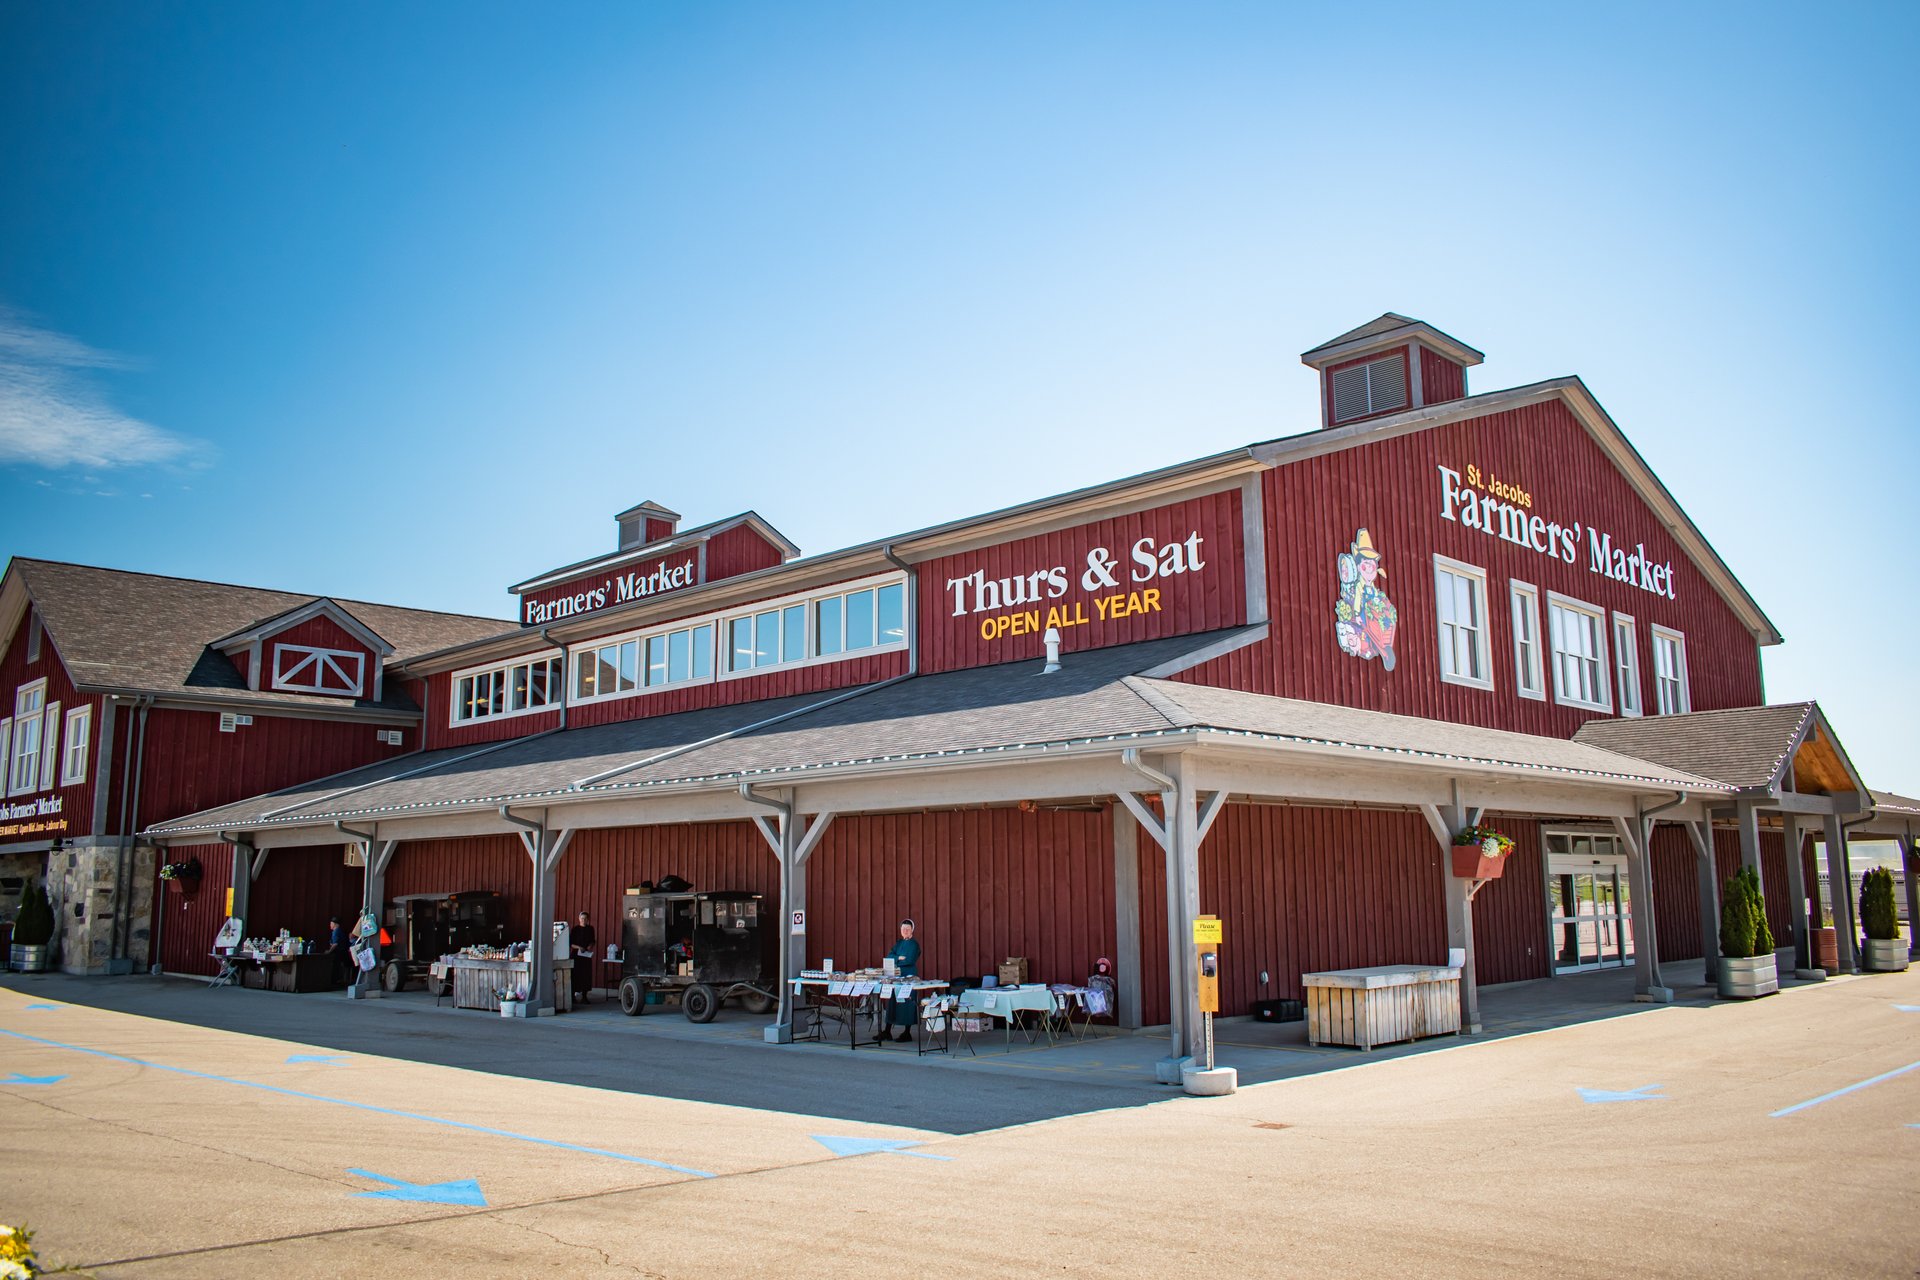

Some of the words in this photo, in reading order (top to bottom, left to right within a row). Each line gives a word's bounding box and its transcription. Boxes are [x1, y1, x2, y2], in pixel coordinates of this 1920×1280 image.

[1467, 463, 1485, 490] St.
[1489, 473, 1532, 508] Jacobs
[1437, 464, 1581, 564] Farmers'
[1587, 526, 1676, 600] Market
[526, 580, 611, 624] Farmers'
[615, 559, 693, 603] Market
[946, 566, 1069, 617] Thurs
[1081, 547, 1120, 592] &
[1131, 530, 1206, 582] Sat
[981, 609, 1040, 640] OPEN
[1045, 602, 1089, 630] ALL
[1094, 588, 1162, 621] YEAR
[38, 795, 63, 815] Market
